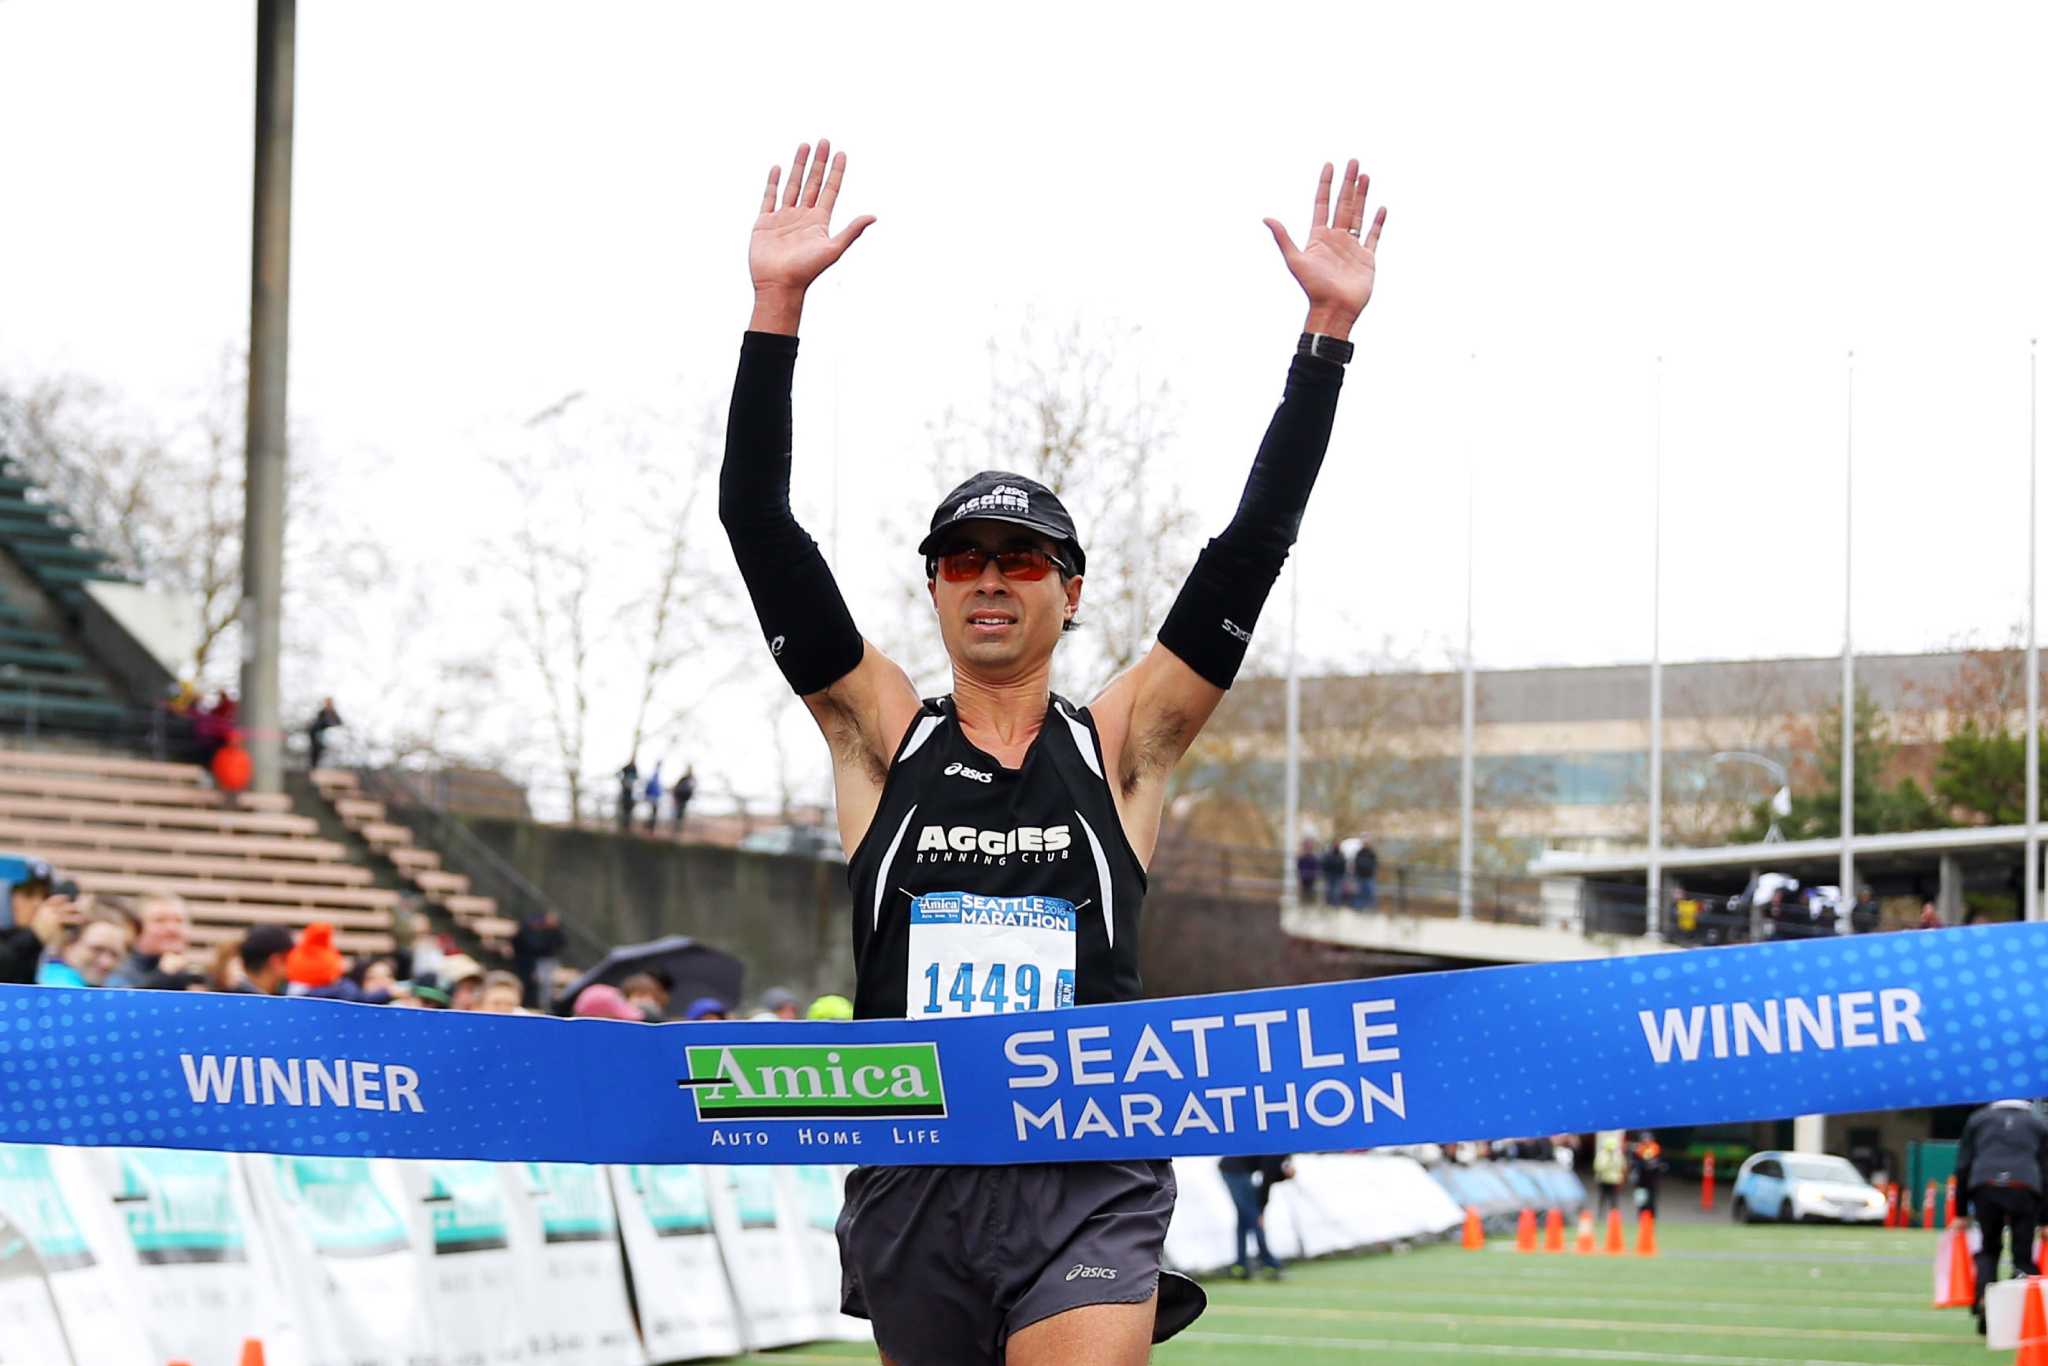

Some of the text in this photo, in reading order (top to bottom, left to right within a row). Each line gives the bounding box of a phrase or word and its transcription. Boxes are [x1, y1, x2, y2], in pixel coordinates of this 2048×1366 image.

[954, 495, 1029, 514] AGGIES
[960, 766, 993, 783] asics
[916, 825, 1071, 856] AGGIES
[917, 850, 1069, 866] RUNNING CLUB
[921, 898, 958, 910] Amica
[961, 894, 1044, 913] SEATTLE
[1044, 905, 1066, 916] 2016
[961, 911, 1069, 931] MARATHON
[923, 962, 1041, 1013] 1449
[1062, 983, 1073, 1003] RUN
[1638, 987, 1926, 1064] WINNER
[1004, 998, 1401, 1089] SEATTLE
[179, 1053, 424, 1113] WINNER
[704, 1047, 930, 1100] Amica
[1012, 1071, 1407, 1141] MARATHON
[1080, 1266, 1118, 1279] asics
